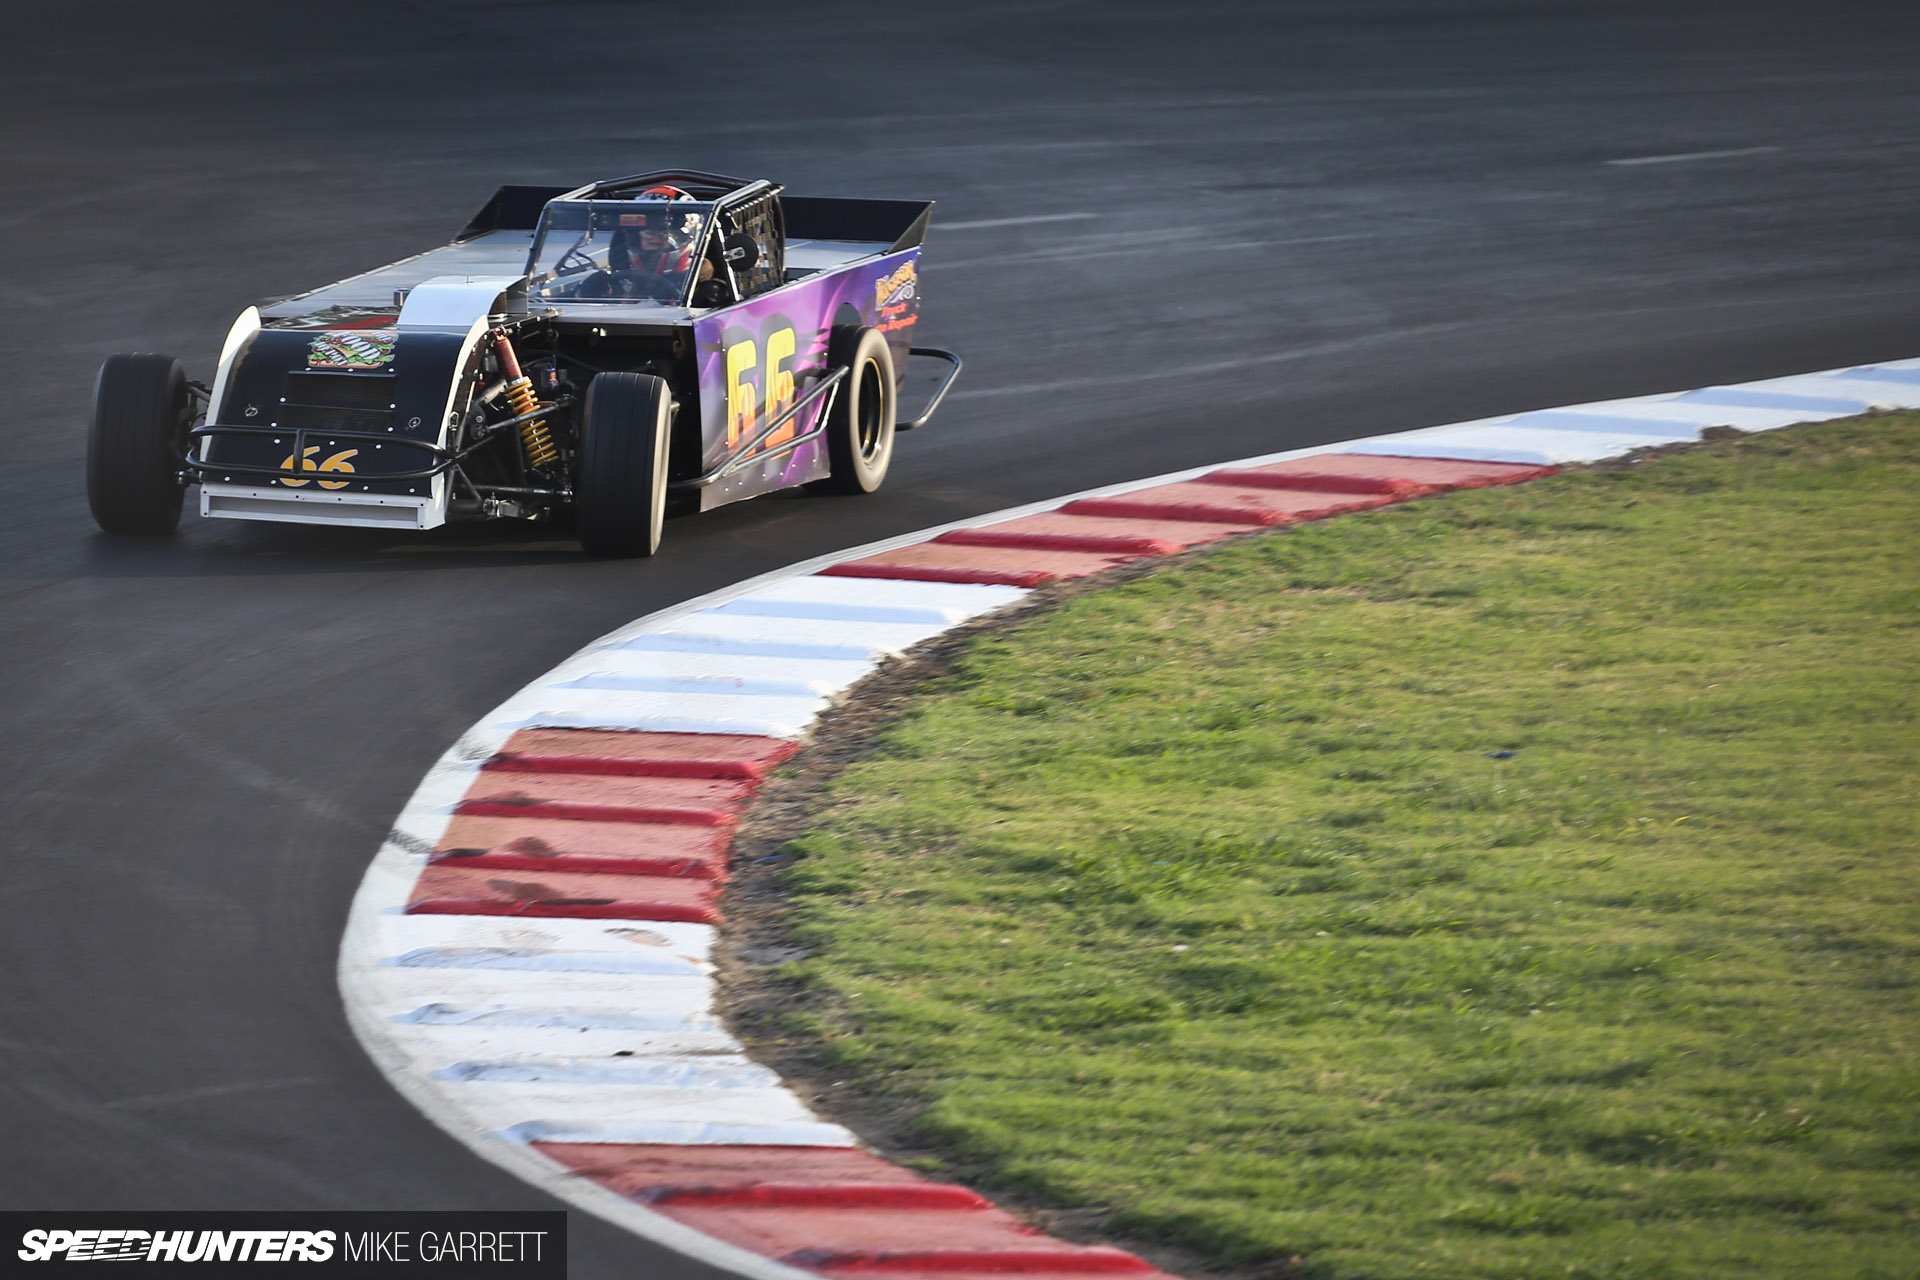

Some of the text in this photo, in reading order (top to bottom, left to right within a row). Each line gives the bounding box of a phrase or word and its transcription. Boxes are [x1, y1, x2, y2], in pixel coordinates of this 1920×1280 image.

[331, 331, 381, 361] FOOD
[727, 327, 796, 461] 66
[280, 446, 359, 490] 66
